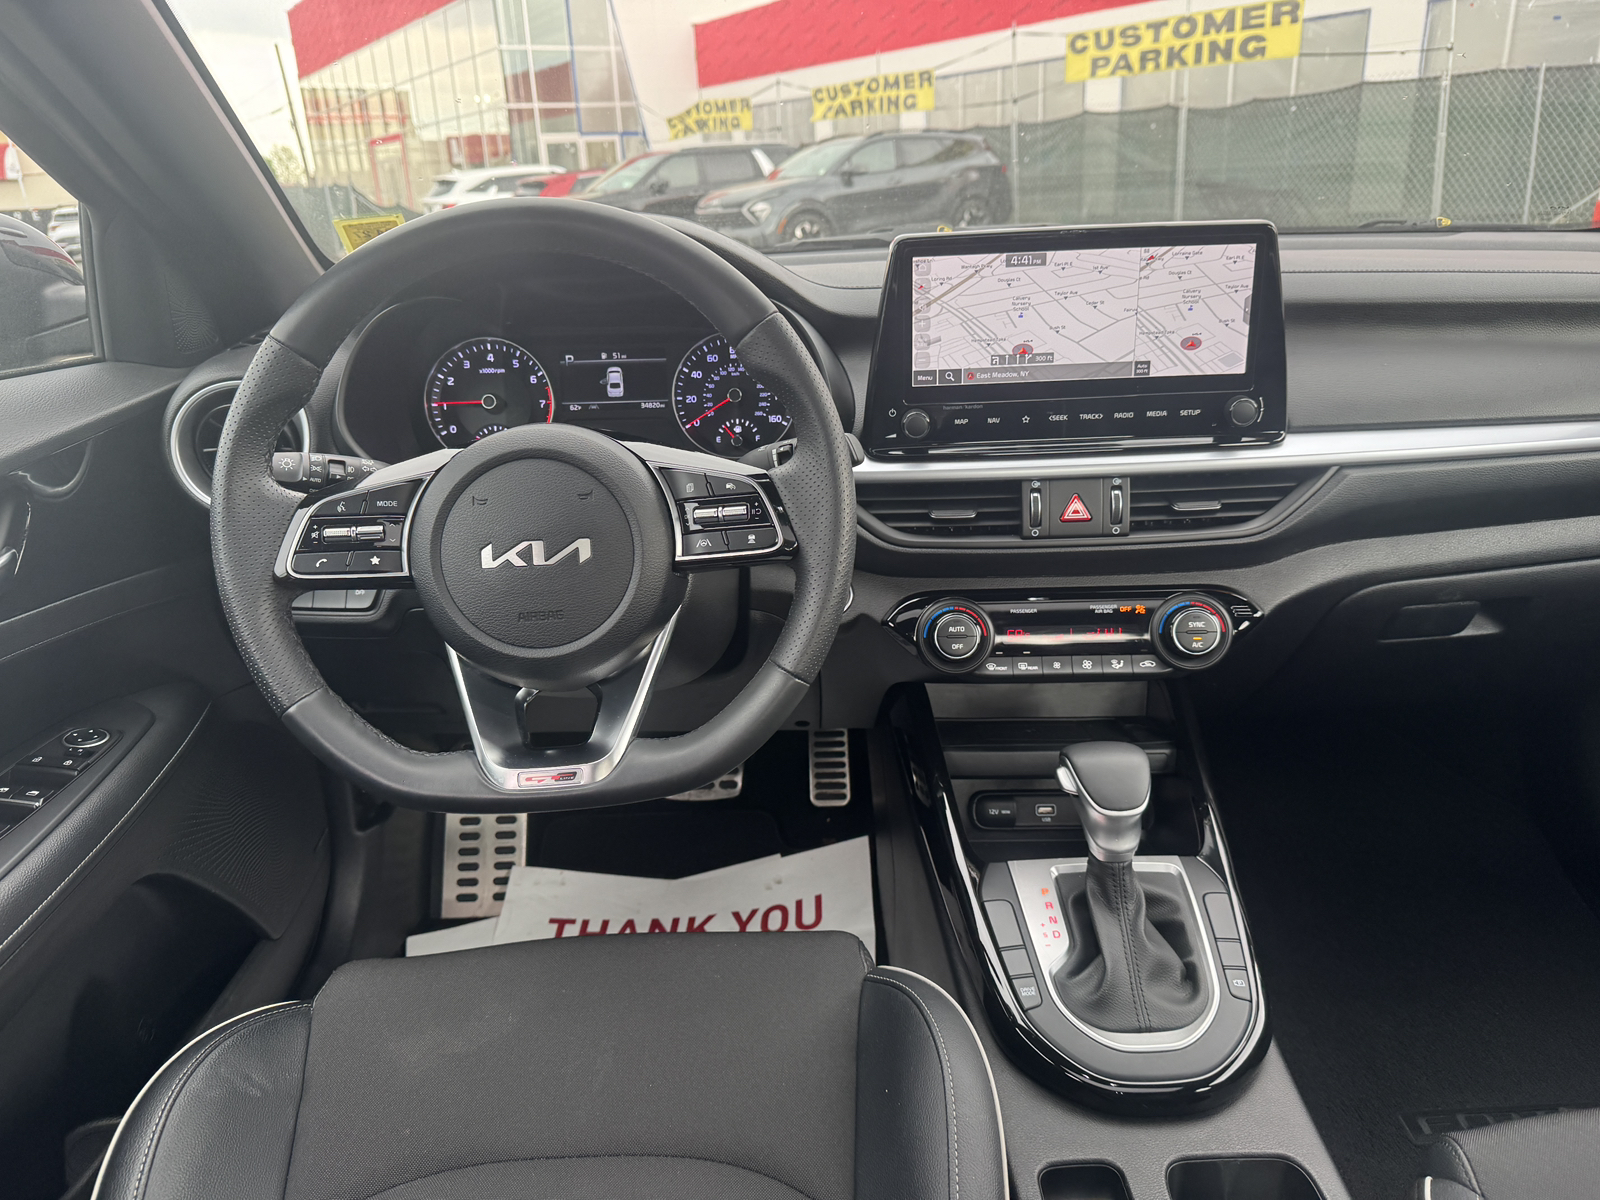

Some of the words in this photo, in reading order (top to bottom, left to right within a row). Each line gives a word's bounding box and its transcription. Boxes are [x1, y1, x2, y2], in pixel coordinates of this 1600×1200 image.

[1069, 0, 1299, 54] CUSTOMER
[1090, 34, 1267, 77] PARKING
[814, 70, 933, 102] CUSTOMER
[1010, 255, 1032, 266] 4:41
[486, 353, 494, 363] 4
[565, 354, 575, 367] P
[706, 354, 719, 363] 60
[463, 360, 471, 369] 3
[512, 359, 520, 368] 5
[690, 371, 702, 379] 40
[992, 370, 1019, 378] Meadow,
[446, 376, 455, 386] 2
[529, 375, 538, 384] 6
[685, 395, 697, 403] 20
[539, 399, 546, 409] 7
[767, 415, 782, 423] 160
[449, 425, 457, 434] 0
[481, 538, 591, 569] KIA
[517, 610, 565, 623] AIRBAG
[1041, 887, 1050, 896] P
[1045, 901, 1054, 910] R
[731, 893, 822, 933] YOU
[1049, 915, 1058, 924] N
[1052, 929, 1061, 939] D
